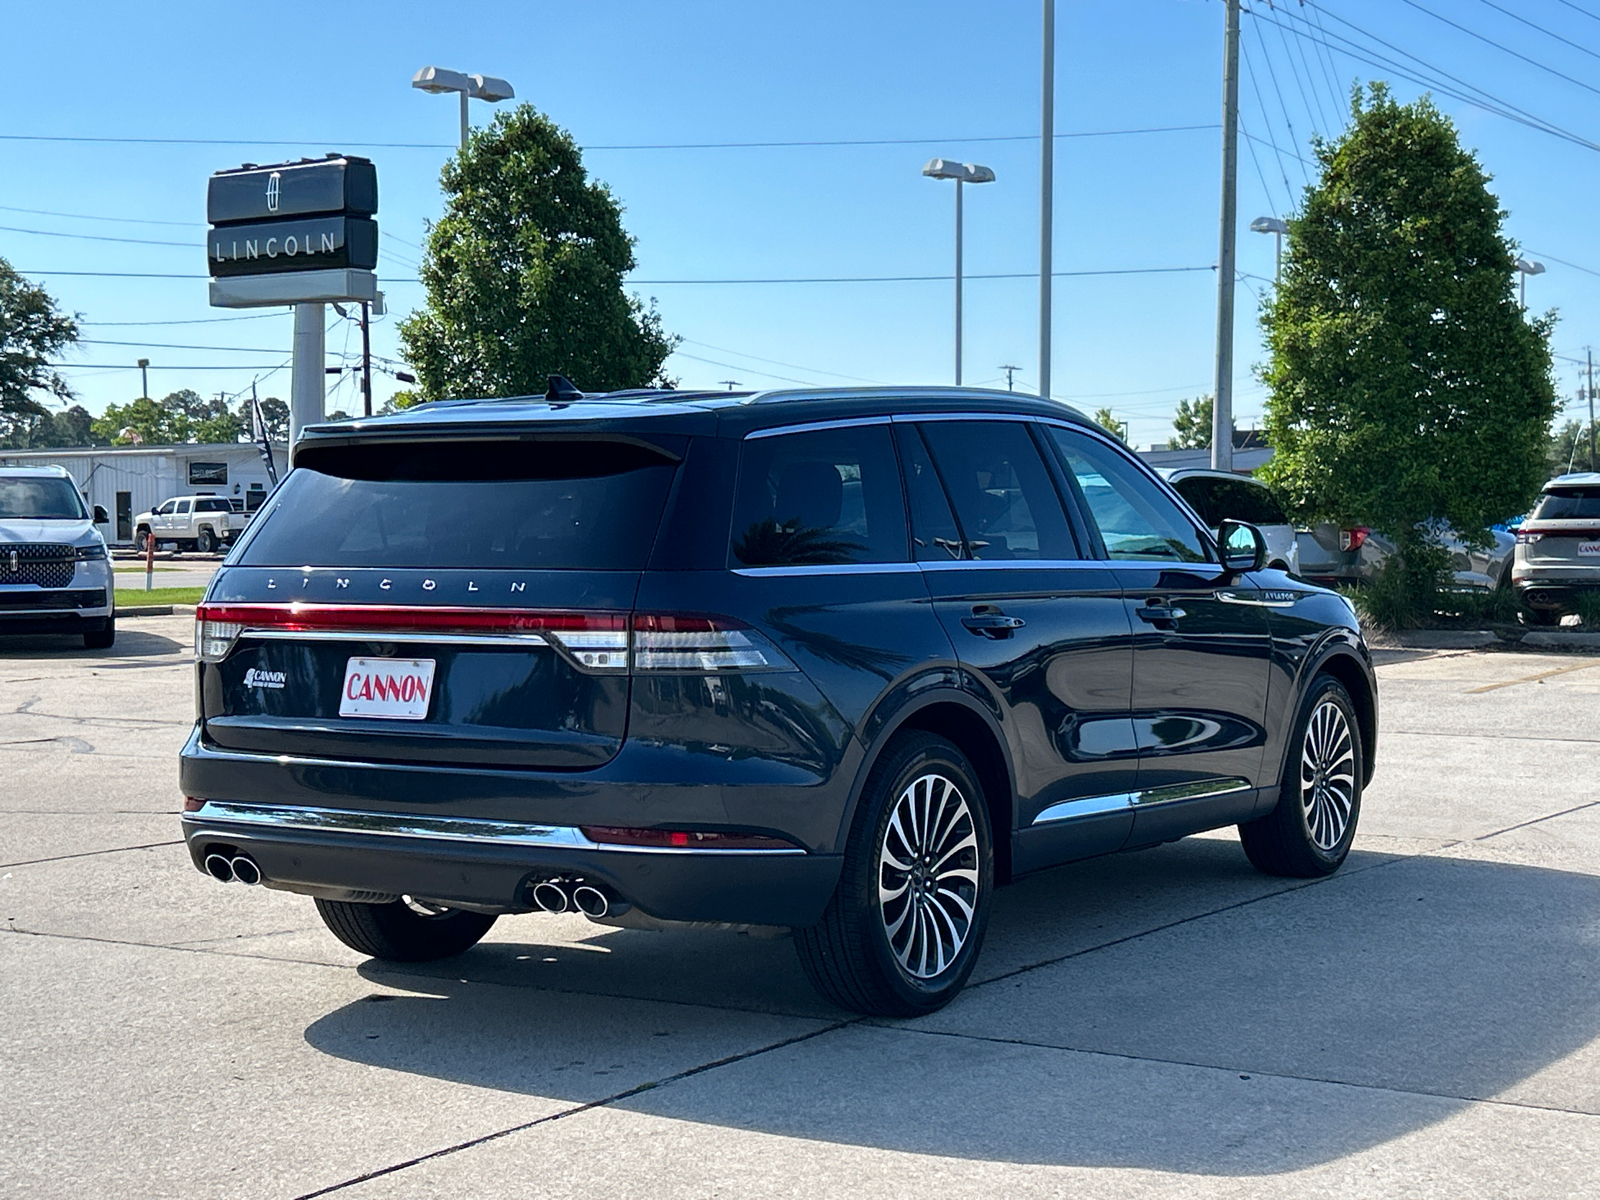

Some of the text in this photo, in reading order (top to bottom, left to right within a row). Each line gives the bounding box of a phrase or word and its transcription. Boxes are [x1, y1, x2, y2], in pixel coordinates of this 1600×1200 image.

[216, 232, 335, 262] LINCOLN
[267, 578, 526, 592] LINCOLN
[254, 670, 287, 683] CANNON
[346, 672, 429, 703] CANNON
